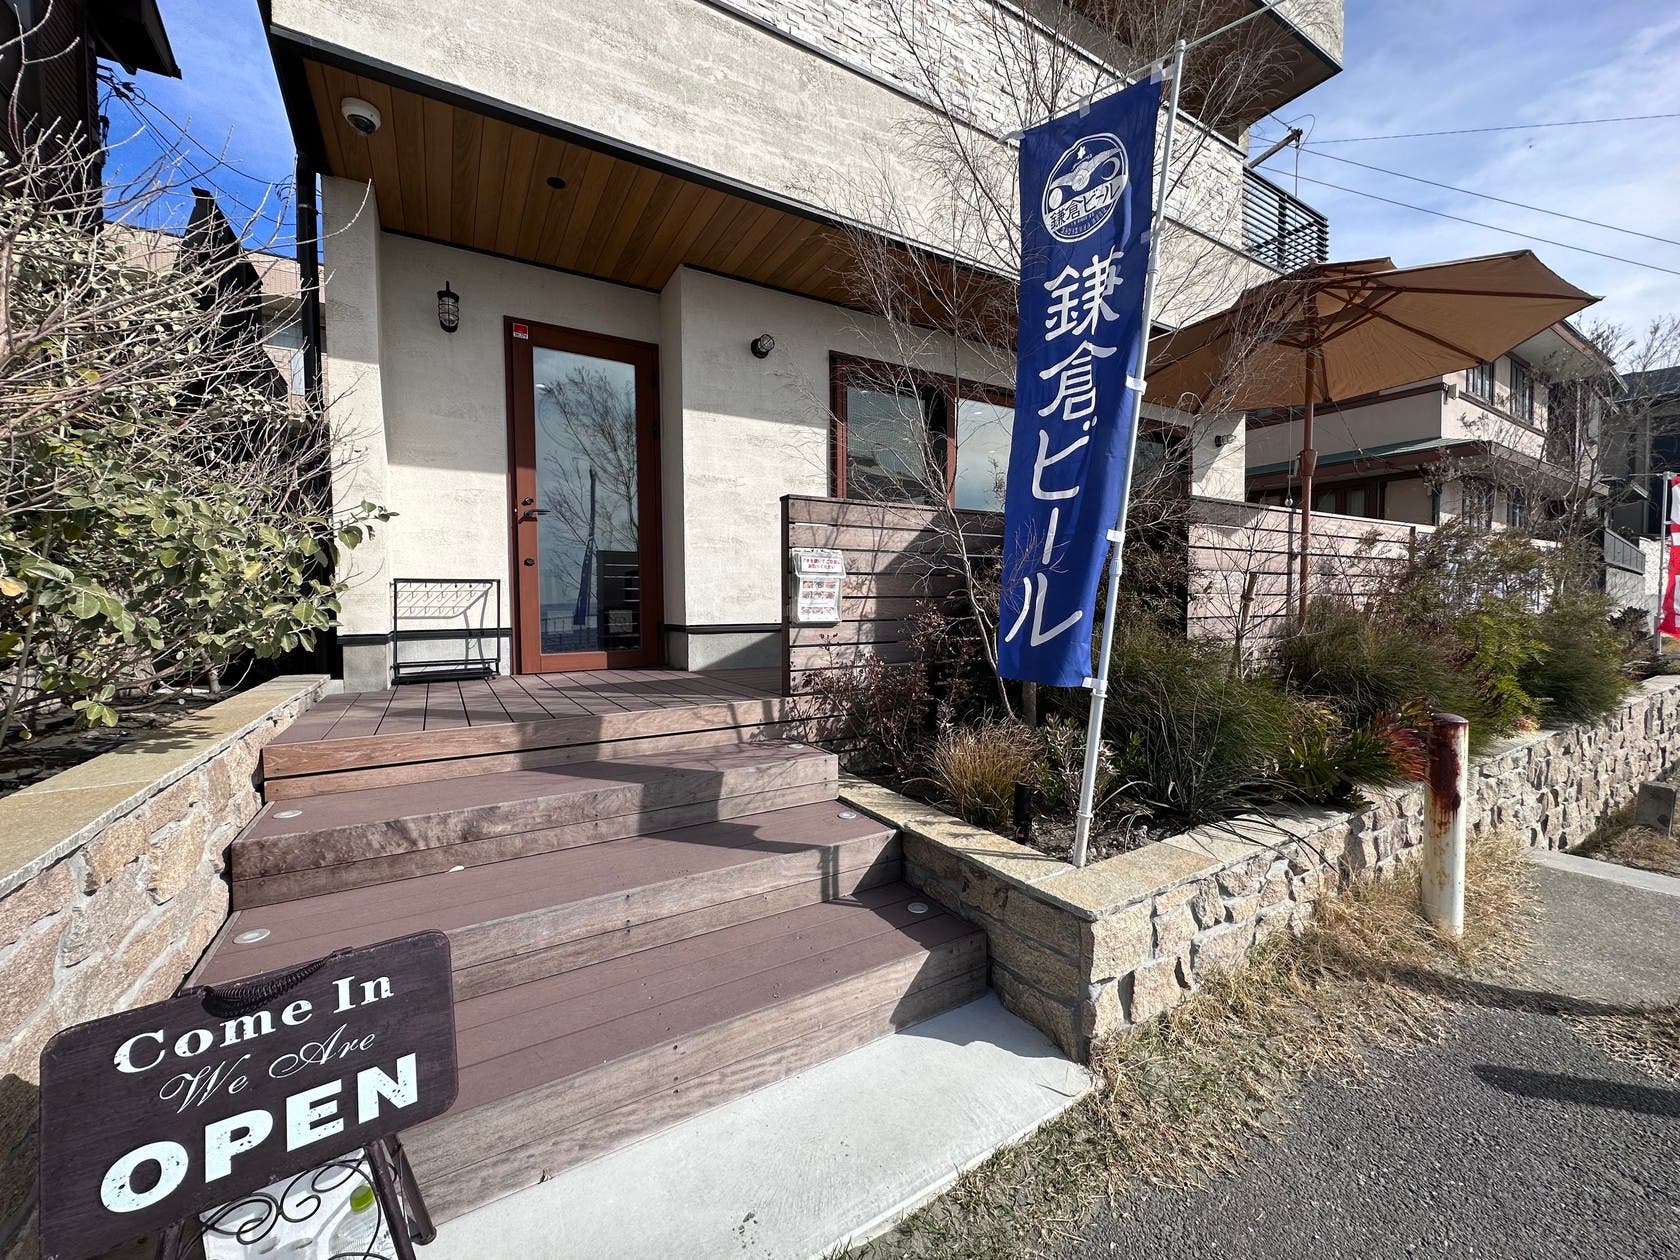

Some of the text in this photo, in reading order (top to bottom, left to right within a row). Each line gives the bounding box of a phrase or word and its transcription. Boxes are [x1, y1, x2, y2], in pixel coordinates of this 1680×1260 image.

[1049, 183, 1120, 230] 鎌倉ビール
[1003, 249, 1124, 648] 鎌倉ビール
[114, 975, 394, 1074] Come In
[159, 1023, 376, 1114] We Are
[100, 1053, 419, 1213] OPEN
